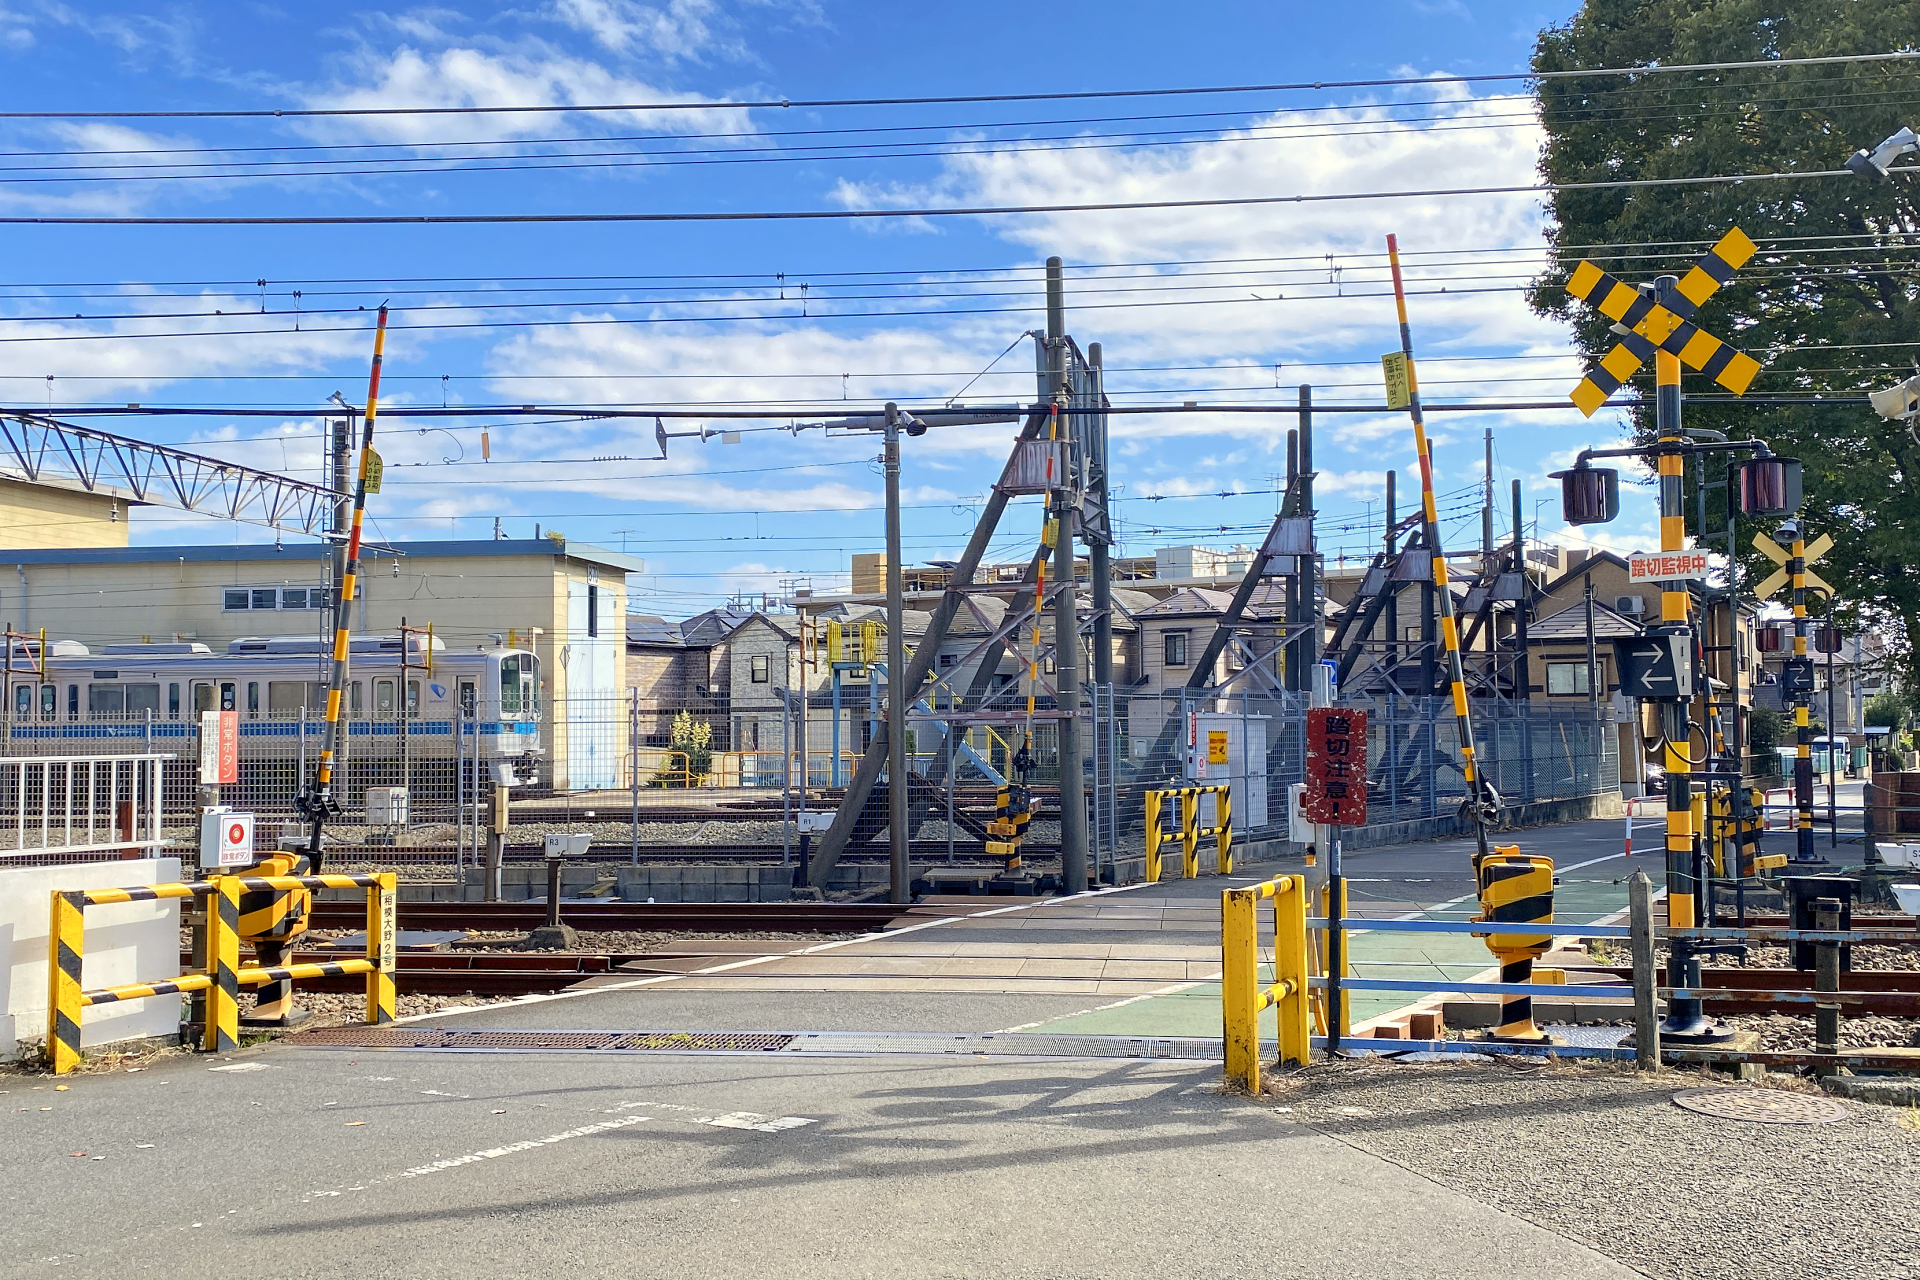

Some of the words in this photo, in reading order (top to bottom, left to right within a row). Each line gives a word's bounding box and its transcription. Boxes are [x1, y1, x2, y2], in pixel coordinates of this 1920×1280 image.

[1631, 554, 1707, 578] 踏切監視中
[223, 716, 234, 778] 非常ボタン
[549, 838, 559, 846] R3
[1912, 849, 1920, 858] S
